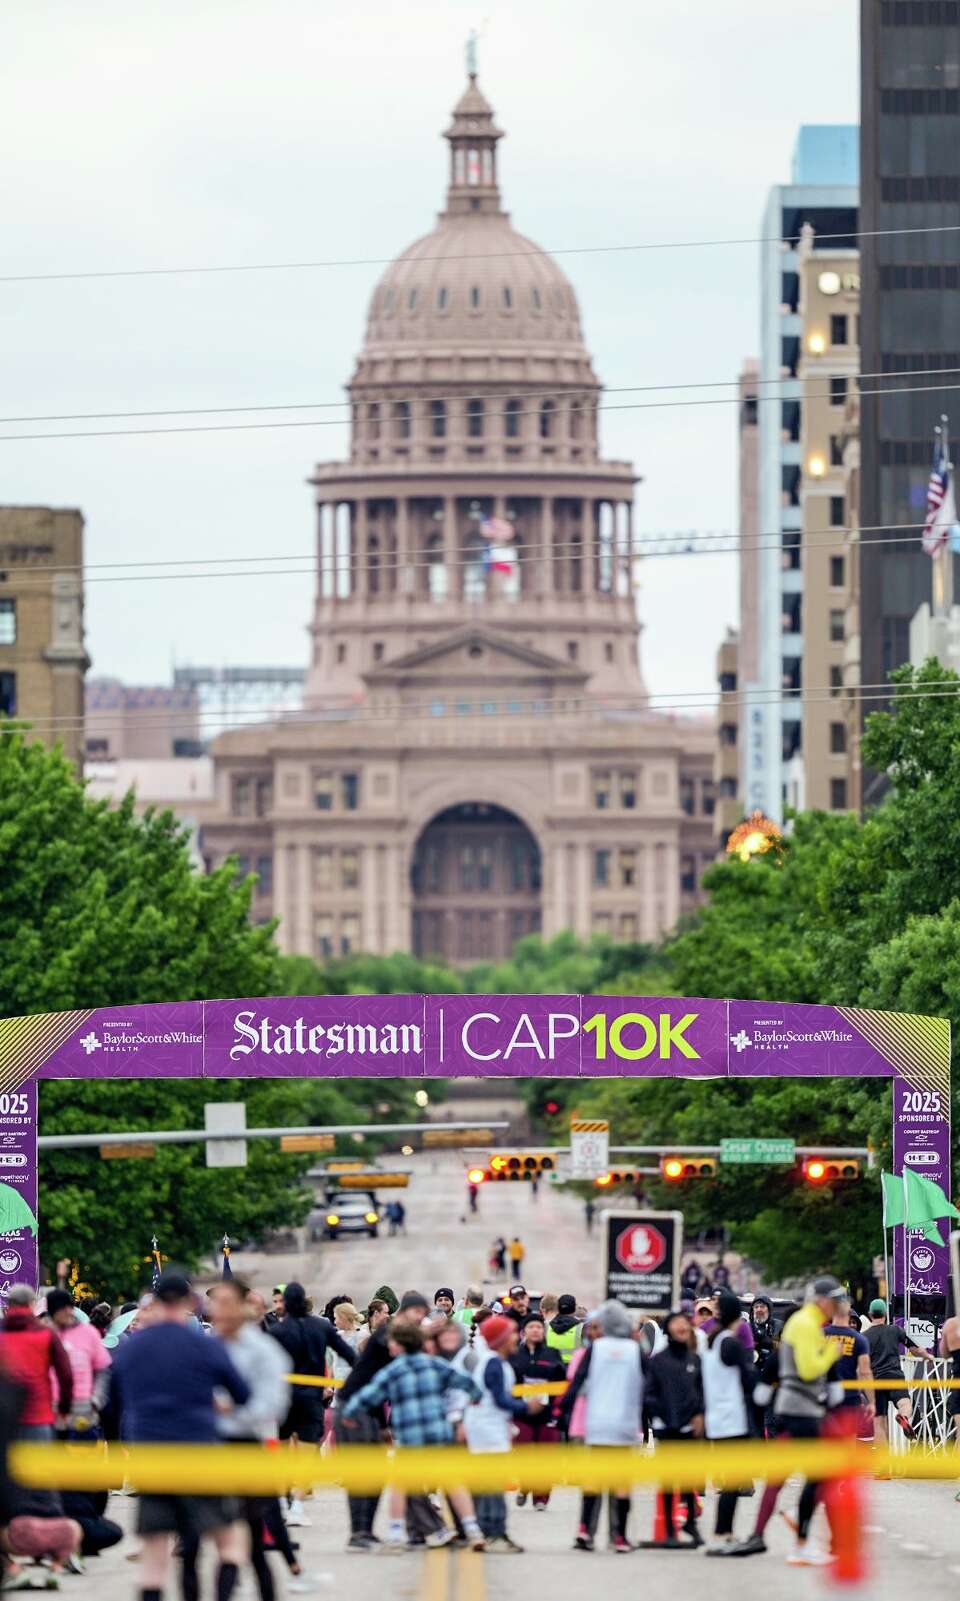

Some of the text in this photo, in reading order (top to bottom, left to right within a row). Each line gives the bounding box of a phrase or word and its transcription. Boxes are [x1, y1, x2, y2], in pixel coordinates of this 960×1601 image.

[229, 1010, 424, 1061] Statesman
[0, 1093, 29, 1115] 025
[902, 1091, 941, 1113] 2025
[899, 1114, 944, 1122] SPONSORED BY
[910, 1323, 934, 1334] TKC
